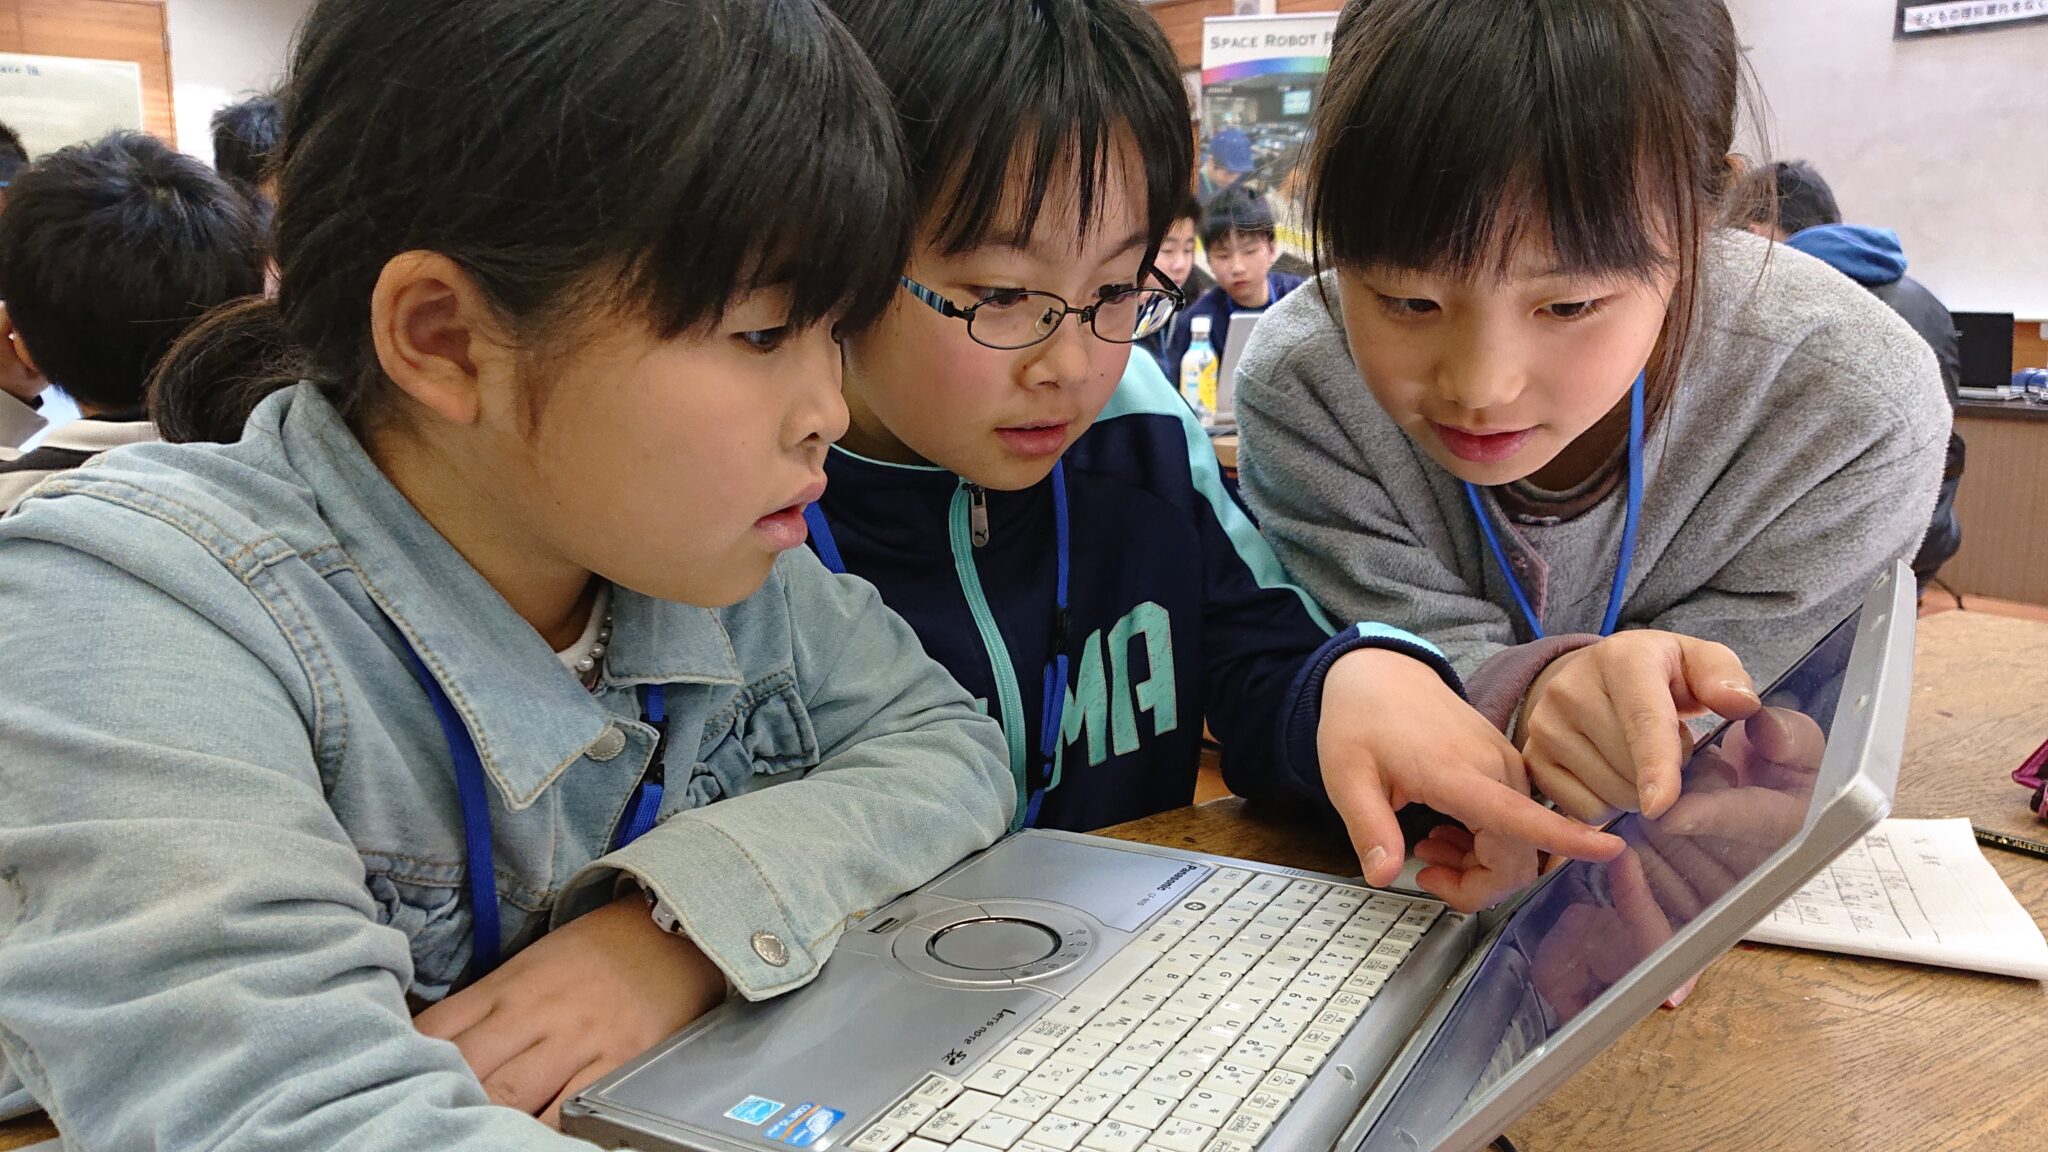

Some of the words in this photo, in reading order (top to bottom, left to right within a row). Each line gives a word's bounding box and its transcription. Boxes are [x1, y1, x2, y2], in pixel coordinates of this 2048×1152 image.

[1264, 33, 1317, 47] ROBOT
[1156, 864, 1198, 891] Panasonic
[1321, 919, 1335, 927] W
[1166, 972, 1179, 980] B
[1141, 994, 1157, 1002] N
[1197, 992, 1212, 1000] H
[1116, 1016, 1132, 1026] M
[1225, 1020, 1240, 1028] U
[1149, 1039, 1165, 1047] K
[1223, 1064, 1237, 1072] 9
[991, 1068, 1006, 1079] Ctrl
[1178, 1069, 1193, 1078] O
[1153, 1097, 1167, 1106] P
[1265, 1098, 1280, 1109] F10
[931, 1112, 955, 1129] PgUp
[1246, 1121, 1260, 1132] F11
[867, 1128, 884, 1142] End
